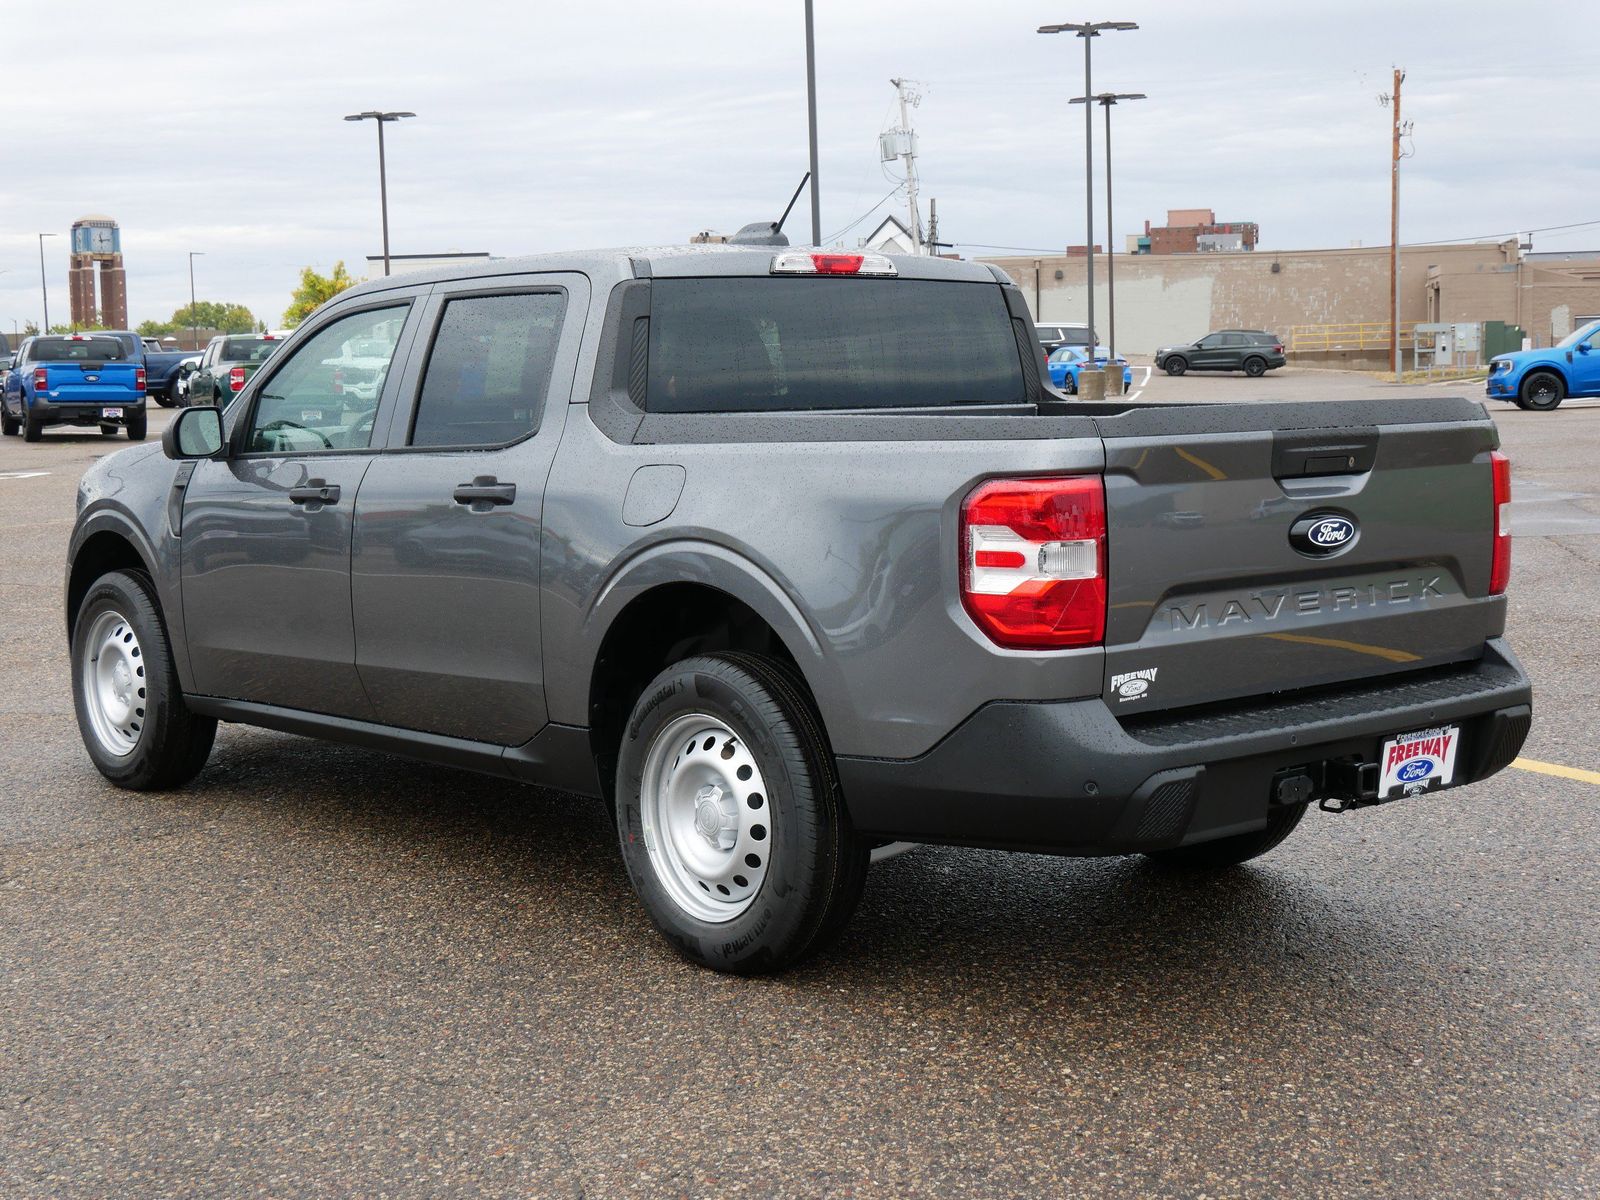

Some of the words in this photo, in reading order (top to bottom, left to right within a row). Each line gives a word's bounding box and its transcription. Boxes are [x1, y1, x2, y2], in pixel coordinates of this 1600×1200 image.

[1317, 522, 1347, 542] Ford
[1170, 576, 1444, 632] MAVERICK
[1110, 667, 1158, 693] FREEWAY
[1386, 735, 1453, 778] FREEWAY
[1402, 761, 1428, 779] Ford
